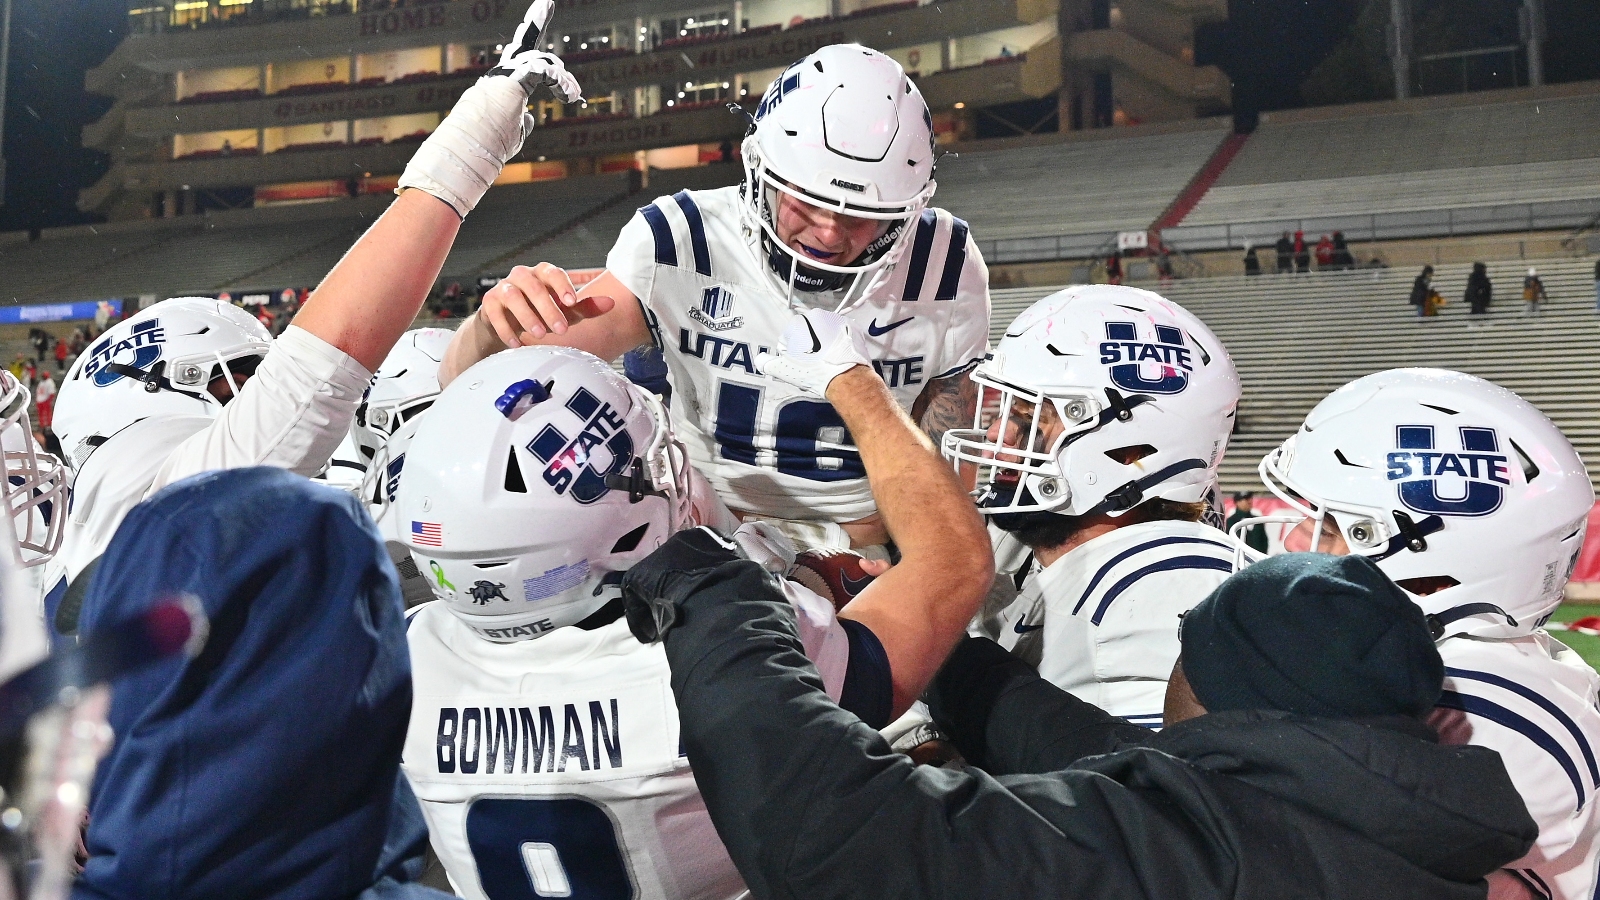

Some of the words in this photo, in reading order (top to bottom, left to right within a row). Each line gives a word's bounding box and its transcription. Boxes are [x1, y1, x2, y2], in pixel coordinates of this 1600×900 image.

[359, 6, 446, 37] HOME
[720, 31, 846, 65] URLACHER
[294, 93, 396, 117] SANTIAGO
[592, 121, 672, 145] MOORE
[866, 225, 904, 255] Riddell
[84, 327, 167, 379] STATE
[1100, 341, 1193, 371] STATE
[542, 402, 626, 495] STATE
[1386, 451, 1511, 486] STATE
[483, 618, 555, 639] STATE
[436, 698, 623, 775] BOWMAN
